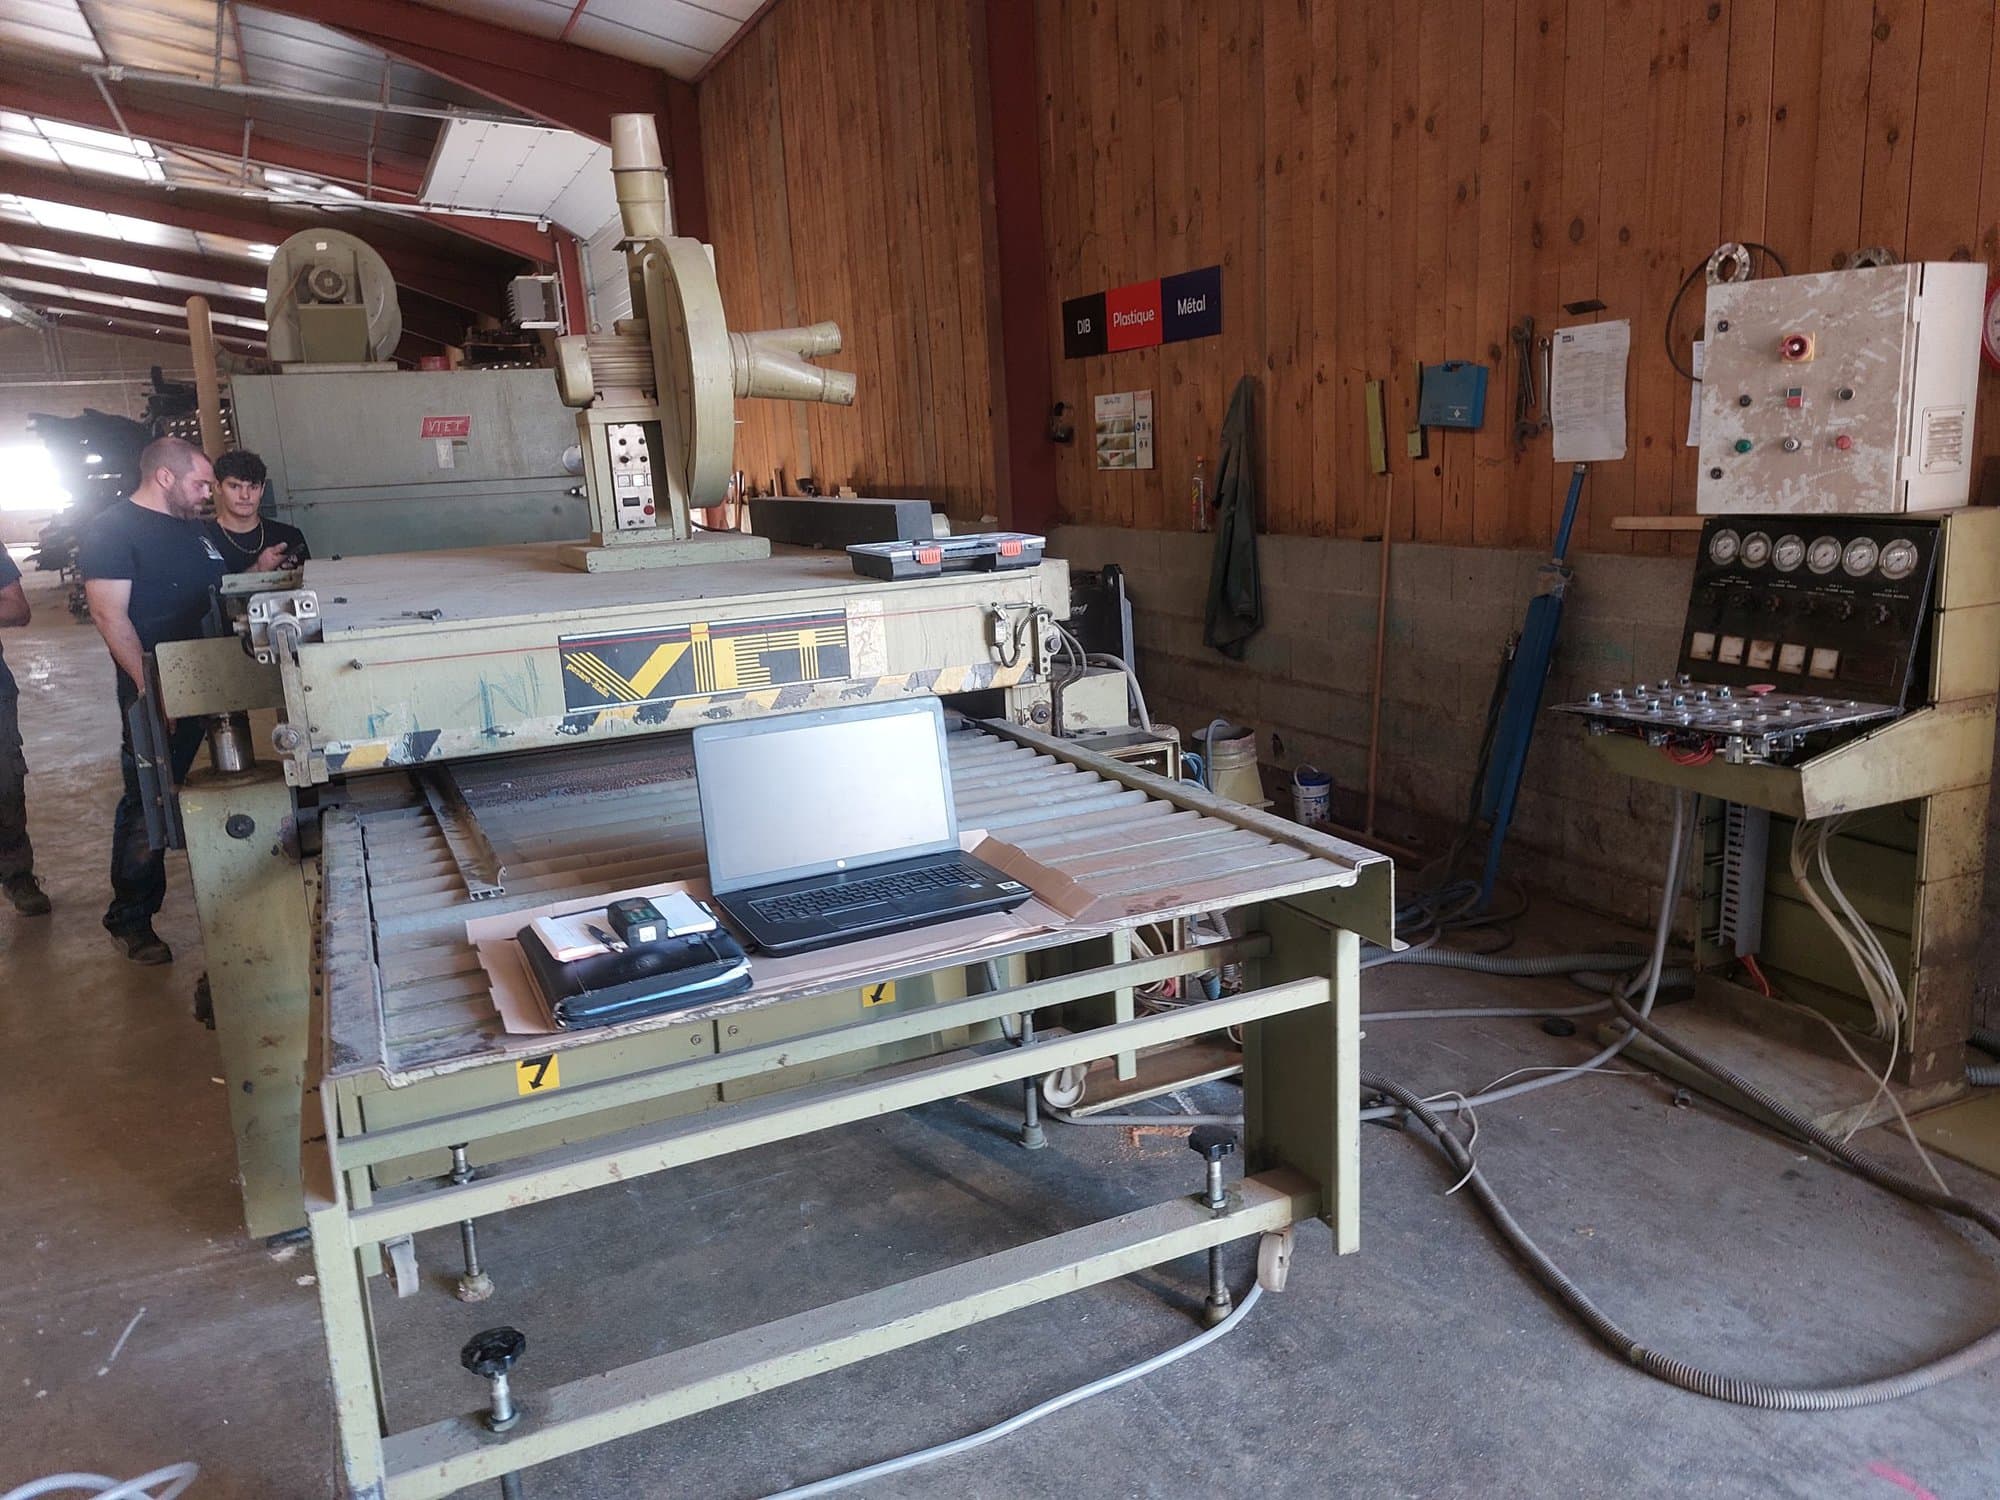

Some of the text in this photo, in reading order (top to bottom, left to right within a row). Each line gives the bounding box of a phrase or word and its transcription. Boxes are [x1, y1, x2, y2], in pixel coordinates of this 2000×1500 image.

[1177, 294, 1206, 316] Métal
[1077, 318, 1091, 335] DIB
[1113, 308, 1155, 328] Plastique
[428, 420, 465, 433] VIET
[563, 622, 846, 701] VIET
